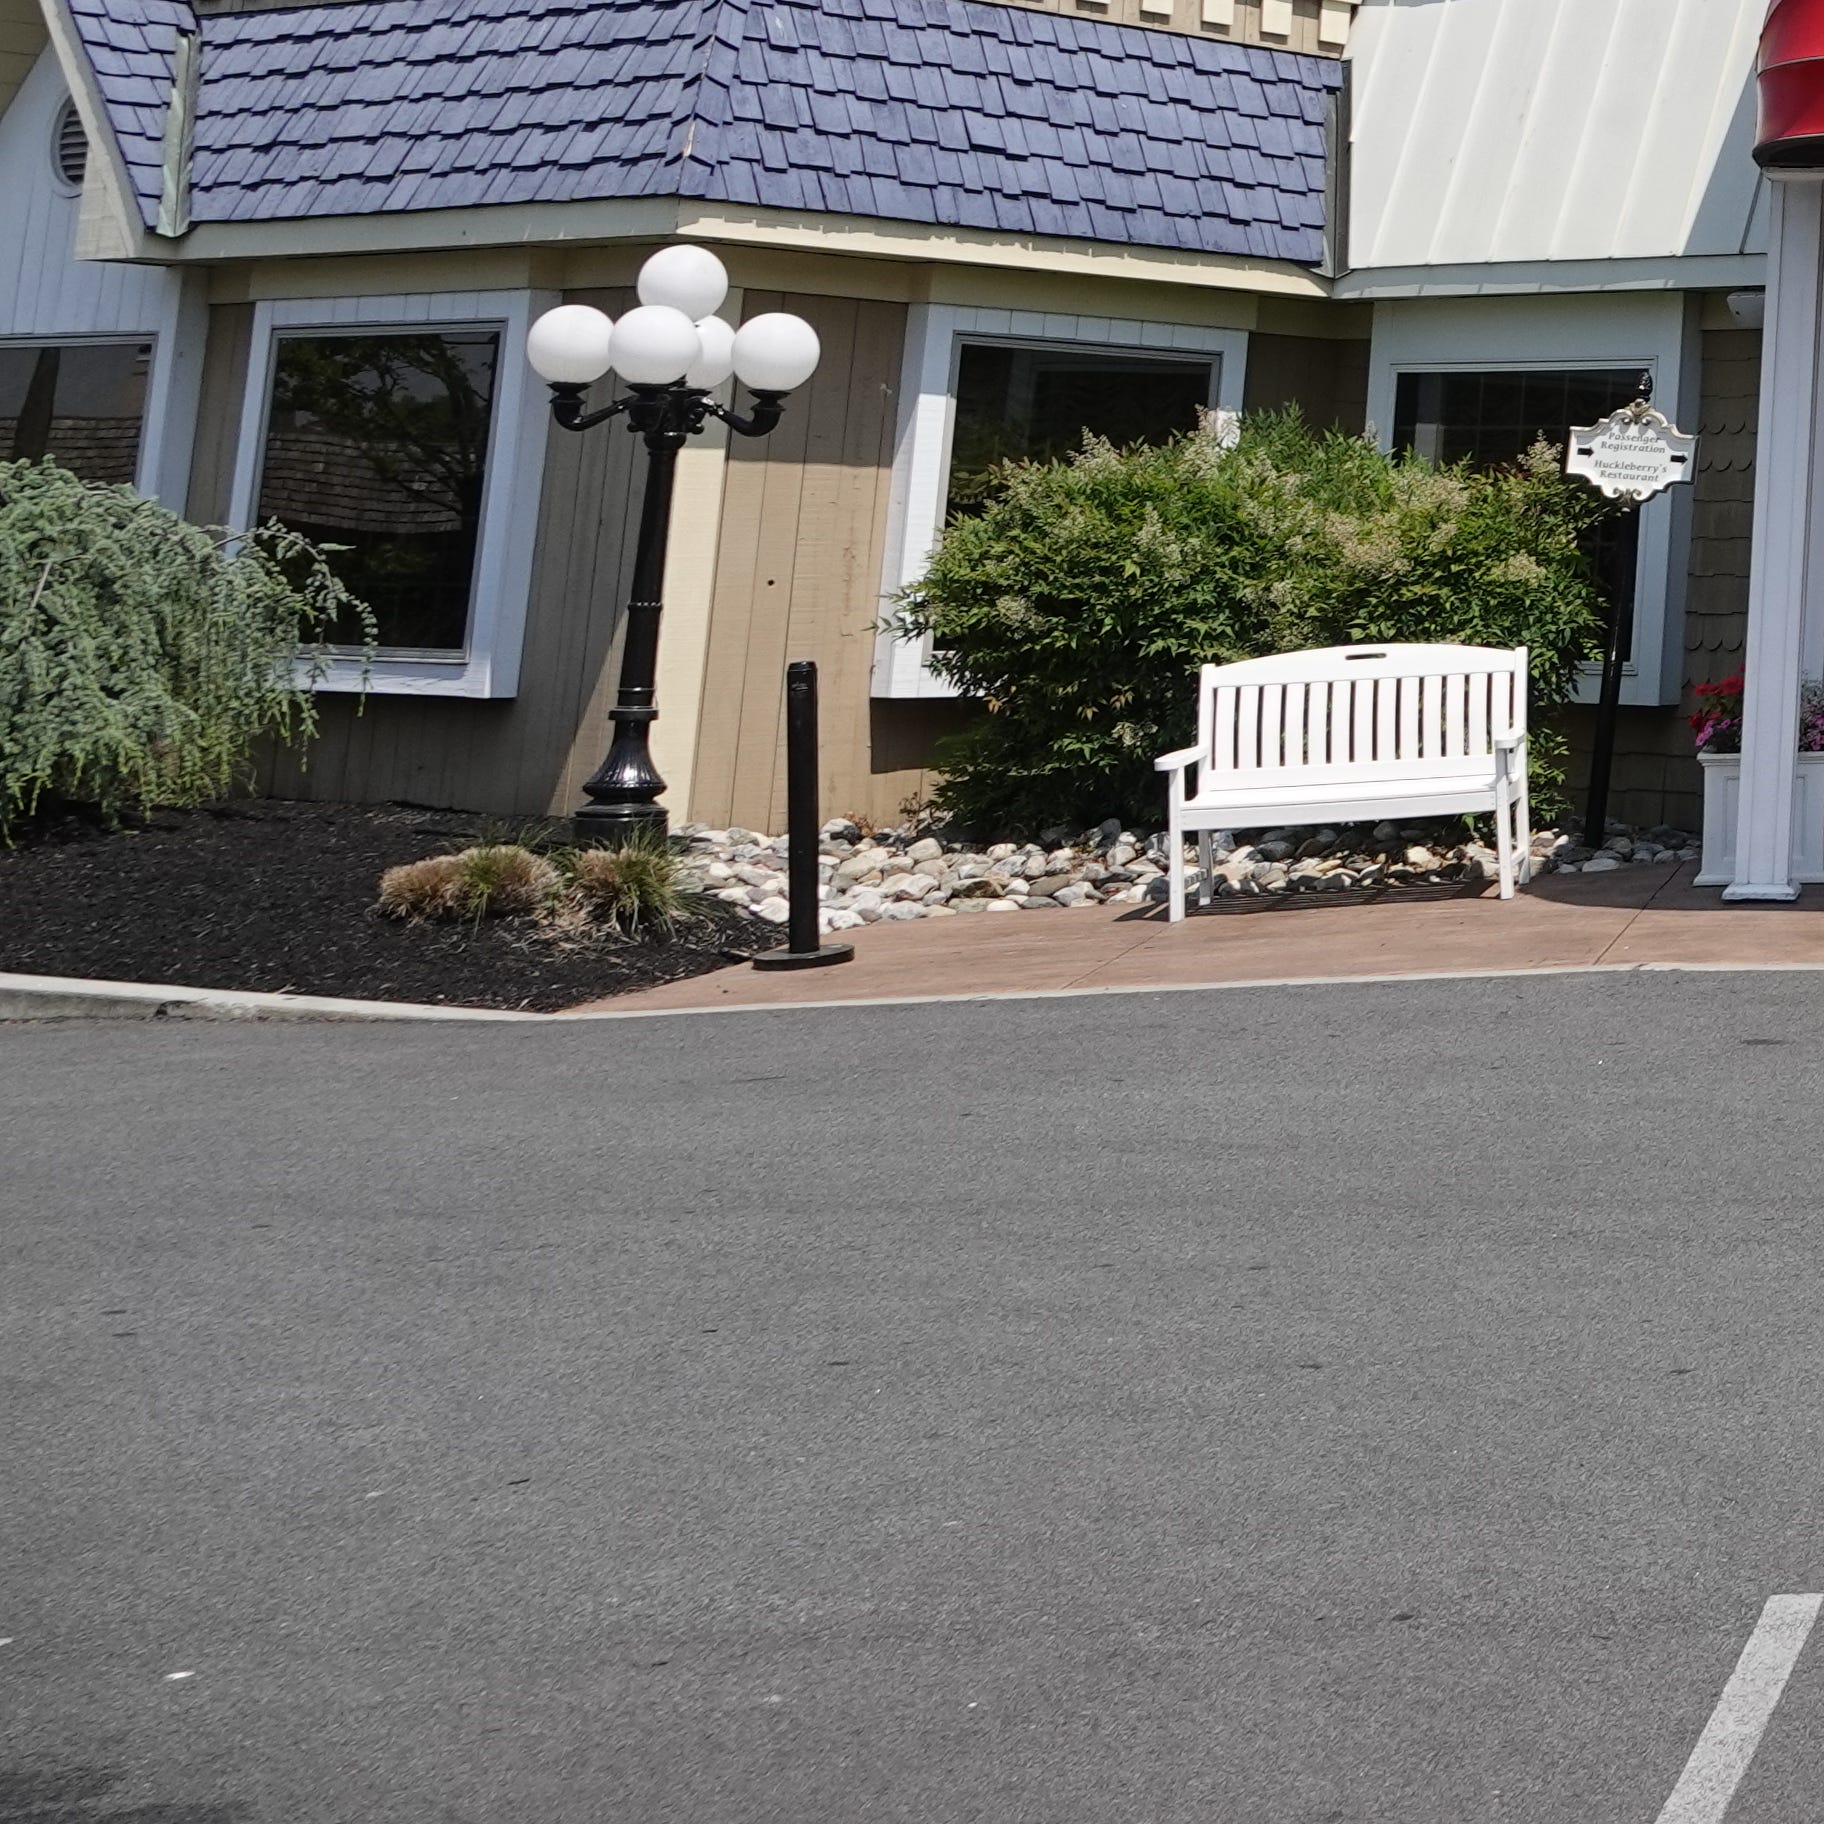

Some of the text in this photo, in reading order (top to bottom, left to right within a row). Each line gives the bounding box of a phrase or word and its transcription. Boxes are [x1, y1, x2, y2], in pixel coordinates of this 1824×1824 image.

[1608, 432, 1660, 445] Passenger
[1600, 441, 1666, 454] Registration
[1594, 460, 1668, 474] Huckleberry's
[1600, 470, 1660, 482] Restaurant
